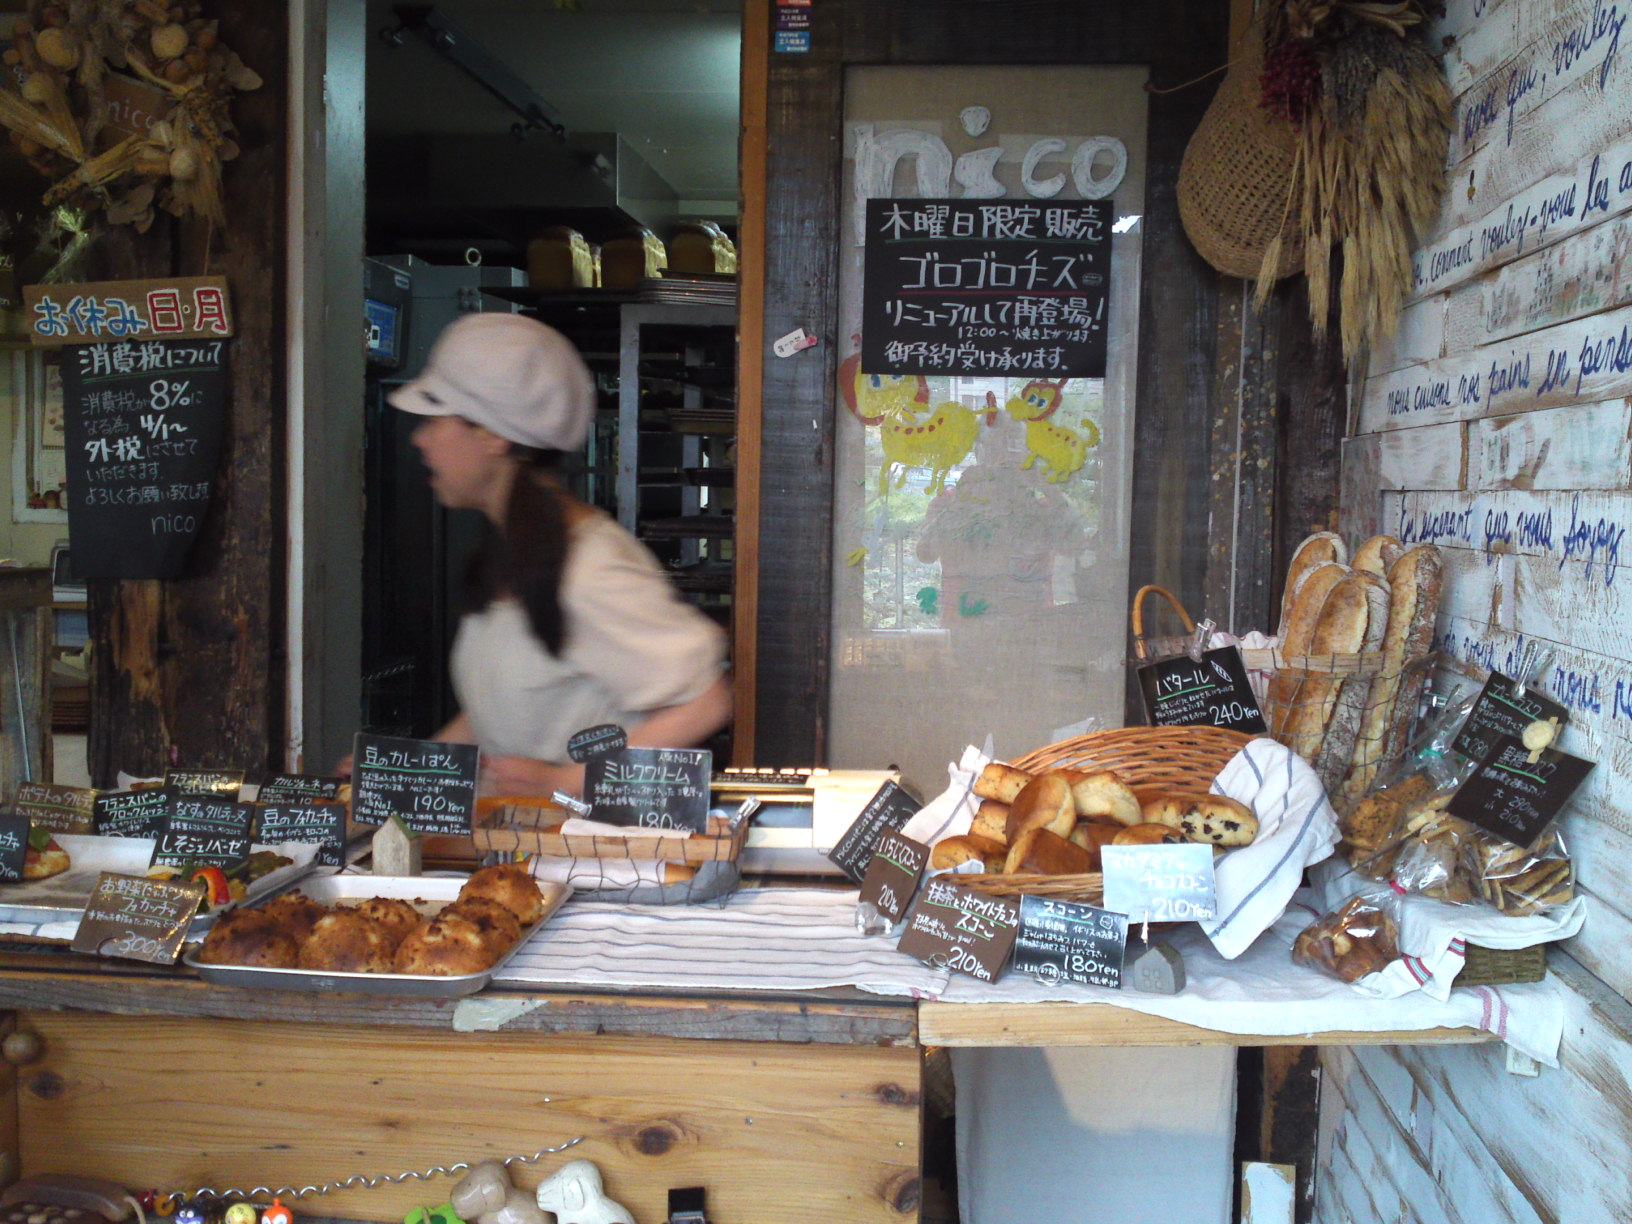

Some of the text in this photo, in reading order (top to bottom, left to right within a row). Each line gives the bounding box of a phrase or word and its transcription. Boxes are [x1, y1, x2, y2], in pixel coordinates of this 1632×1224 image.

[853, 105, 1128, 247] nico
[880, 203, 1103, 240] 木曜日限定販売
[79, 342, 222, 375] 消費税について
[152, 514, 195, 534] nico
[1156, 669, 1210, 696] バタール
[365, 746, 458, 769] 豆のカレーぱん
[604, 760, 690, 783] ミルククリーム
[263, 808, 337, 826] 豆のフォカッチャ
[1044, 901, 1093, 920] スコーン
[955, 911, 995, 938] スコーン
